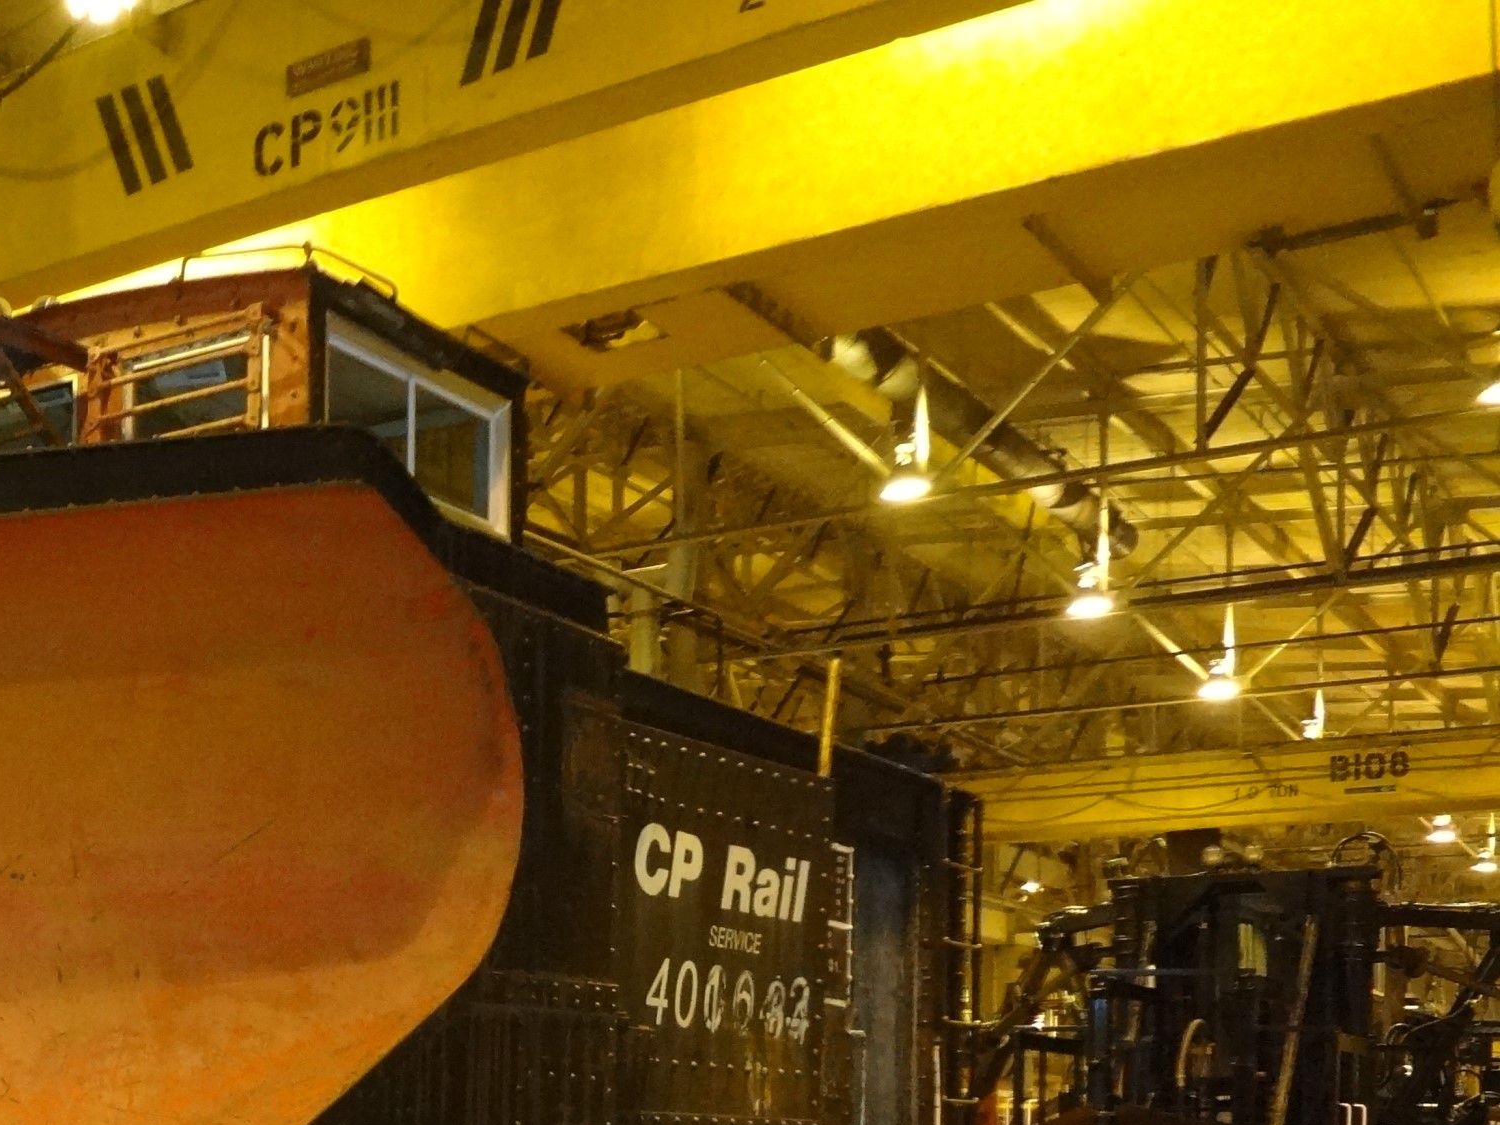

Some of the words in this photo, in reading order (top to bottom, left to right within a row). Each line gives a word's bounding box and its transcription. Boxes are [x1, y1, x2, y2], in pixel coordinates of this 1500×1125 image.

[634, 822, 704, 898] CP
[720, 844, 811, 923] Rail
[708, 925, 762, 955] SERVICE
